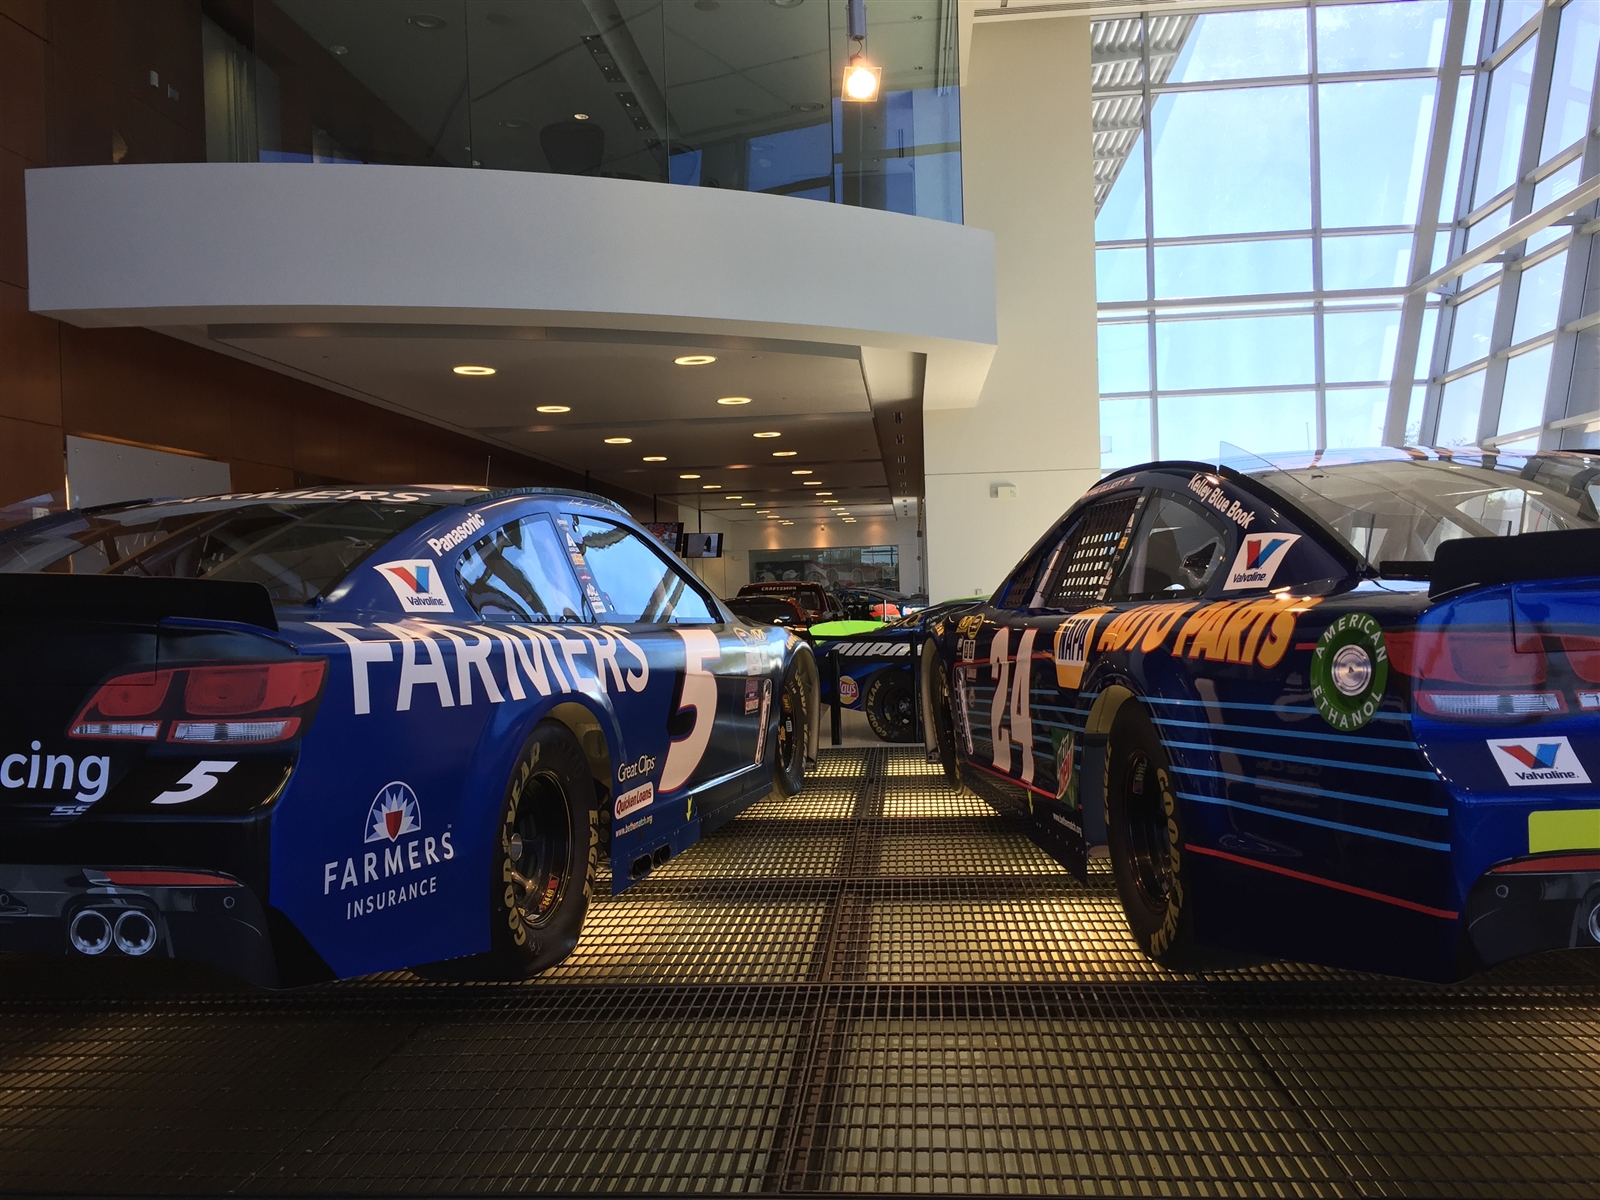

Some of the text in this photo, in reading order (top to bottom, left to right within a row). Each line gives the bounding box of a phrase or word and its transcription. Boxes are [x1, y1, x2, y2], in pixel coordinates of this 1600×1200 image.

[1188, 473, 1255, 529] Kelley Blue Book
[427, 512, 485, 557] Panasonic
[1233, 572, 1267, 583] Valvoline
[406, 596, 444, 606] Valvoline
[1058, 618, 1095, 661] NAPA
[1096, 597, 1323, 670] AUTO PARTS
[1316, 614, 1387, 662] AMERICAN
[305, 621, 649, 715] FARMERS
[840, 682, 856, 697] ays
[658, 627, 721, 794] 5
[990, 626, 1039, 786] 24
[1313, 685, 1382, 728] ETHANOL
[0, 740, 110, 802] cing
[151, 760, 238, 804] 5
[617, 755, 655, 782] Great Clips
[1515, 771, 1576, 780] Valvoline
[616, 788, 652, 815] Quicken Loans
[324, 832, 455, 895] FARMERS
[582, 809, 599, 900] EAGLE
[347, 877, 437, 920] INSURANCE
